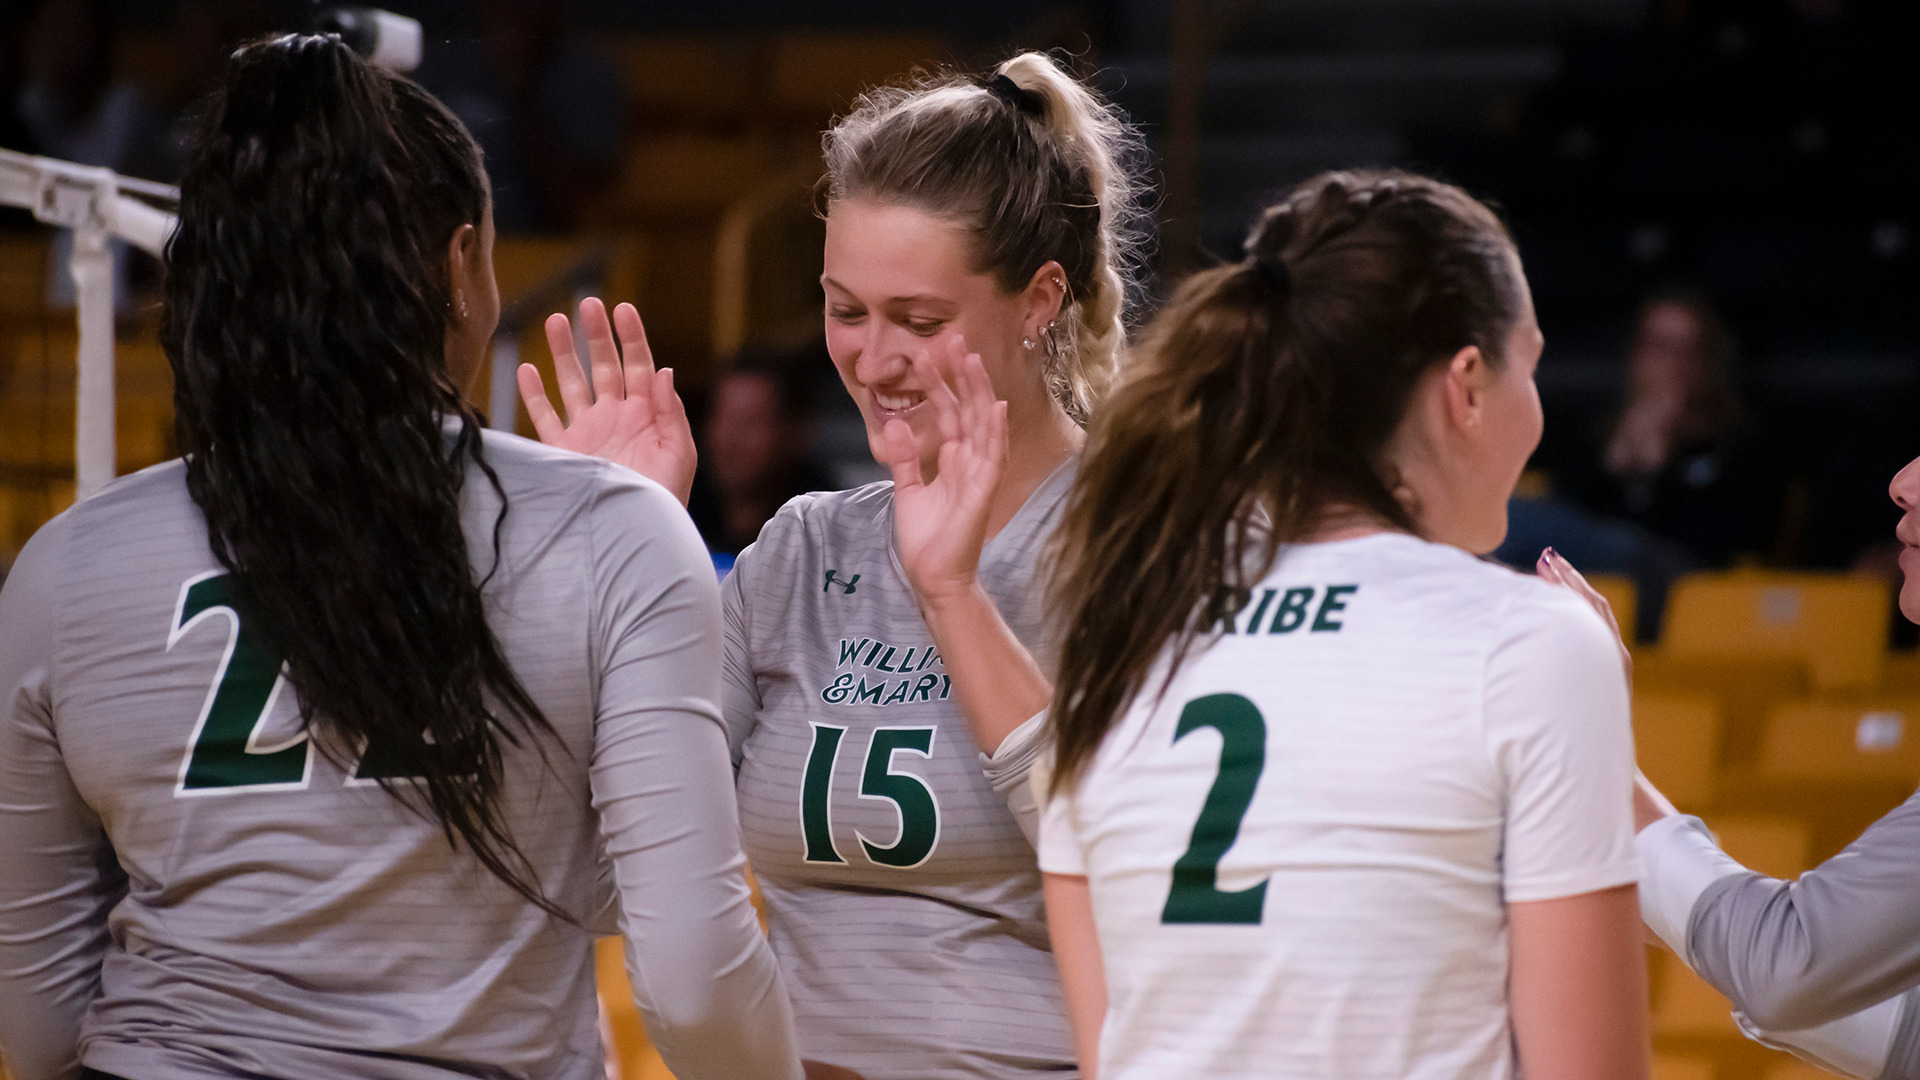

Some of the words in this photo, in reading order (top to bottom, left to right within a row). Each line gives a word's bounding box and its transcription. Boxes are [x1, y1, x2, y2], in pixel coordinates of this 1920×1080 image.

[166, 568, 480, 798] 2
[1196, 583, 1360, 635] RIBE
[800, 721, 941, 869] 15
[1160, 692, 1269, 924] 2
